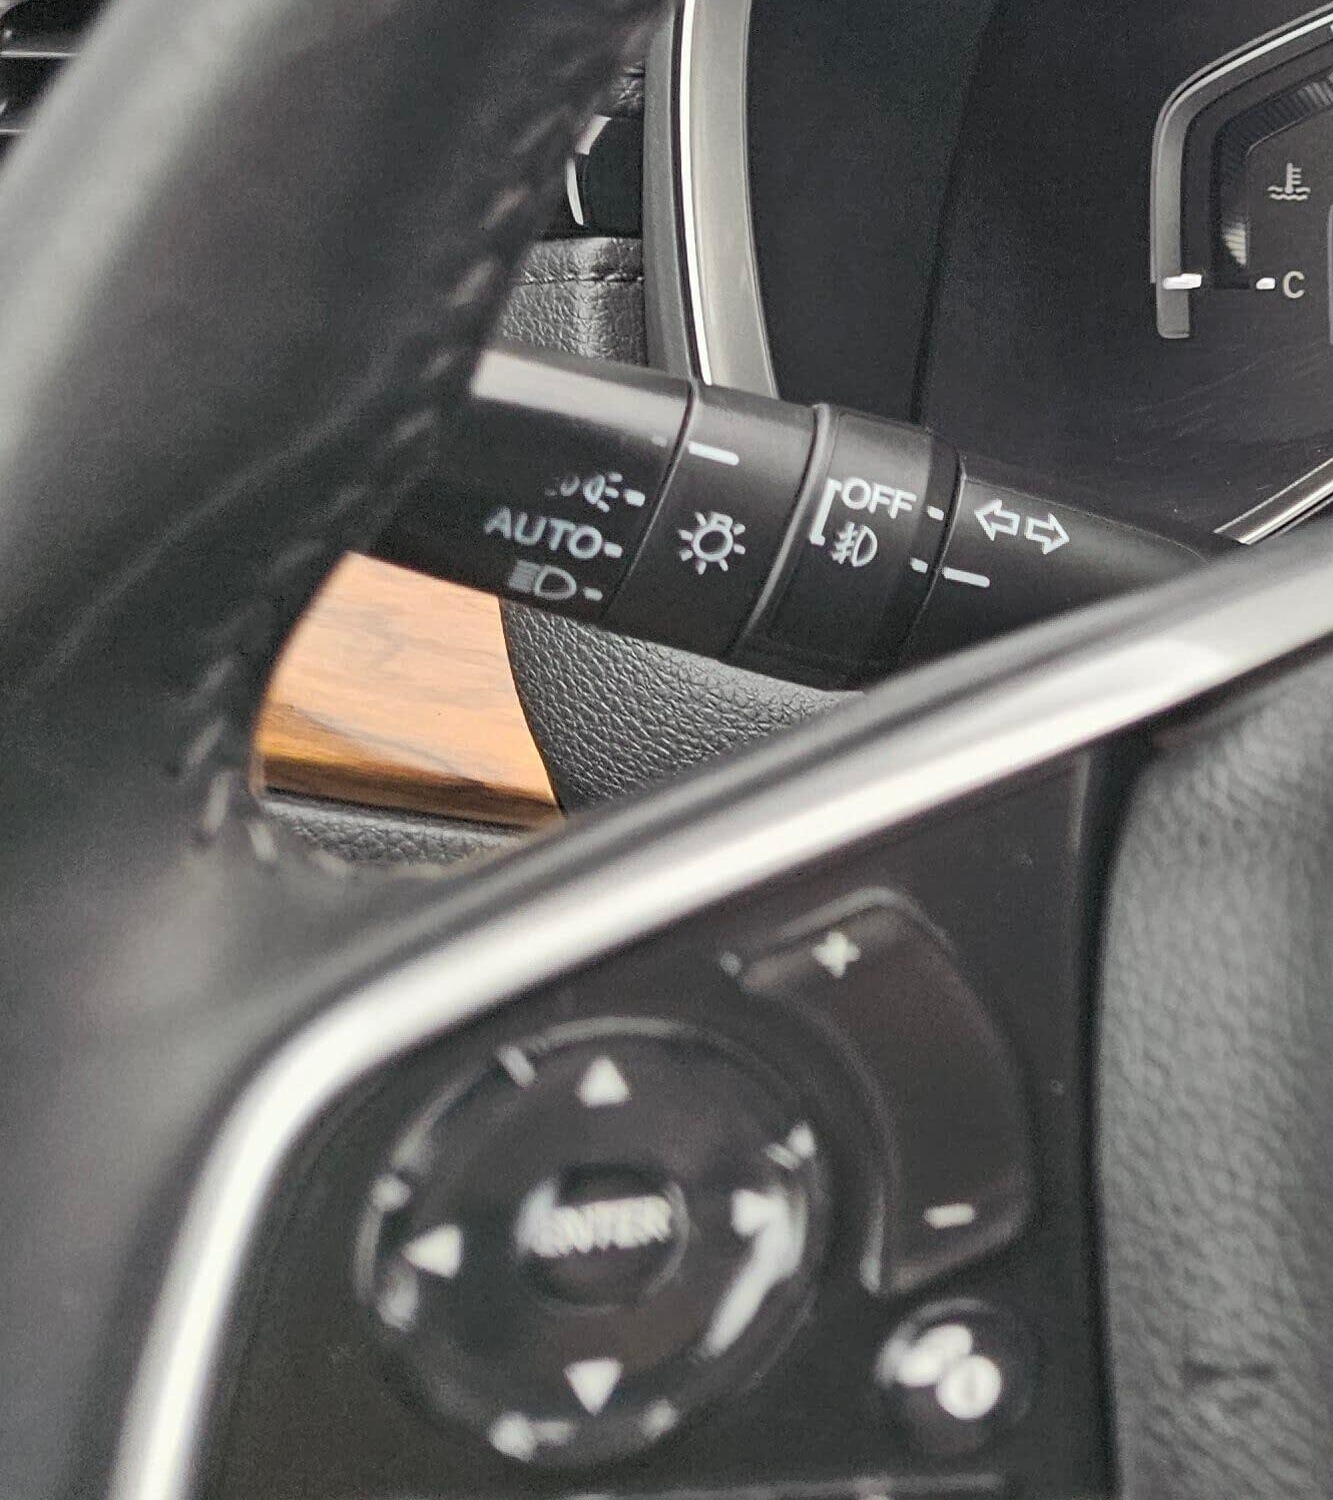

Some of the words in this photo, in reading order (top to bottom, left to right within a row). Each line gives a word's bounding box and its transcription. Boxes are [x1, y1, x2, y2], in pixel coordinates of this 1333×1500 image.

[1282, 270, 1305, 299] C
[841, 476, 918, 519] OFF
[485, 506, 601, 557] AUTO
